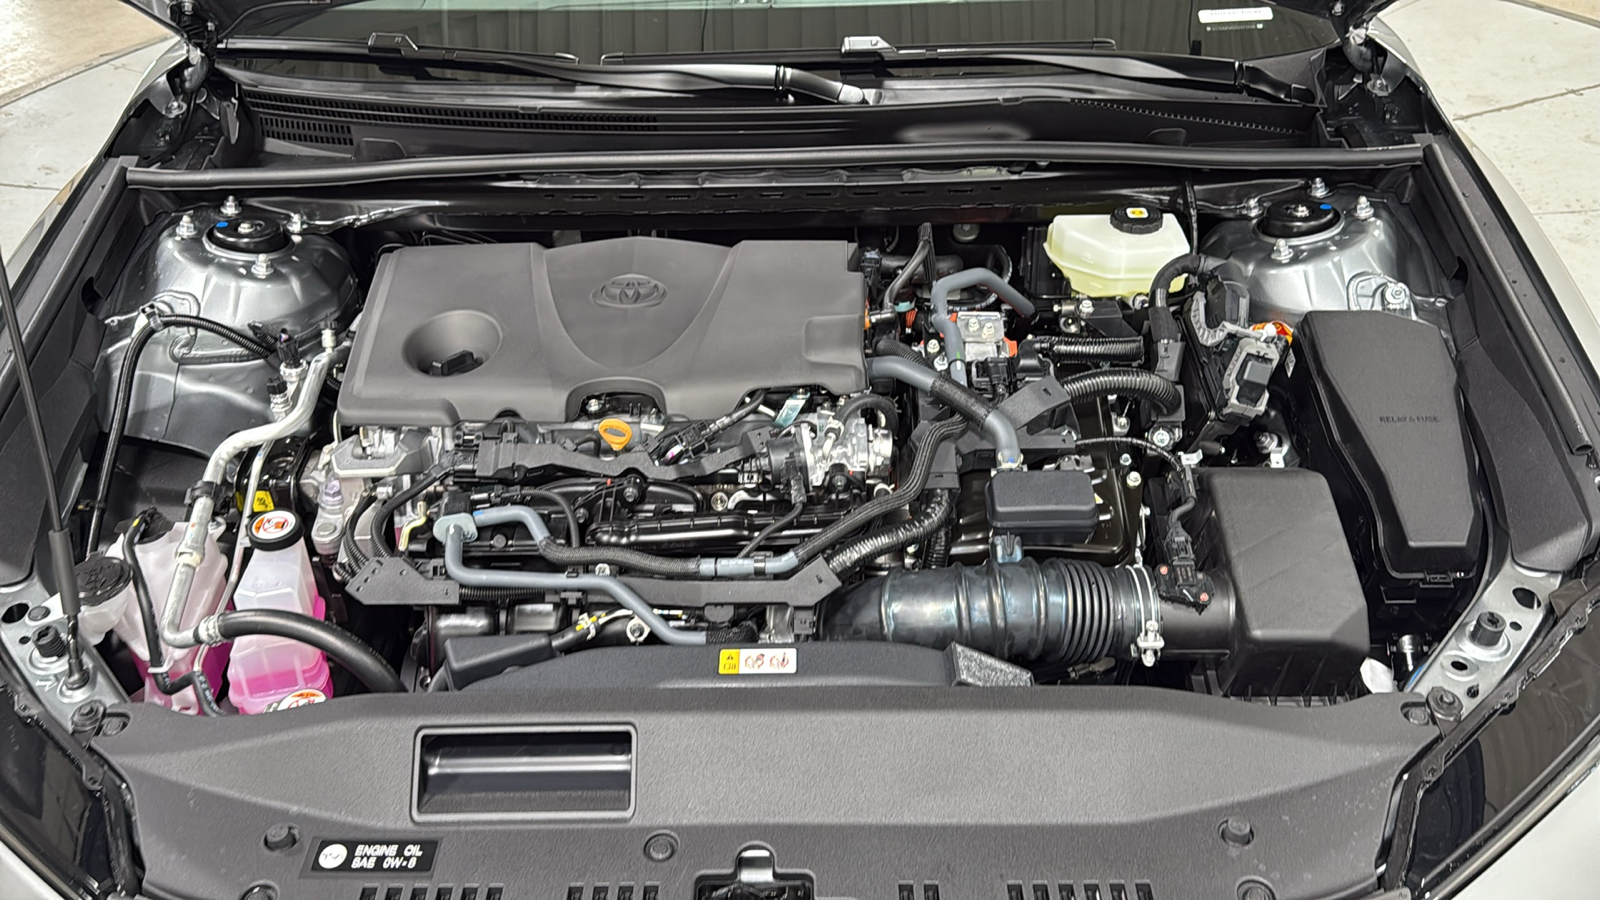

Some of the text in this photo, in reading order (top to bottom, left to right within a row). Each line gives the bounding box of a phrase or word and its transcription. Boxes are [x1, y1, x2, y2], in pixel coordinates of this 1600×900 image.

[1379, 415, 1407, 424] RELAY
[1416, 415, 1440, 423] FUSE
[354, 844, 423, 857] ENGINE OIL
[351, 856, 377, 869] SAE
